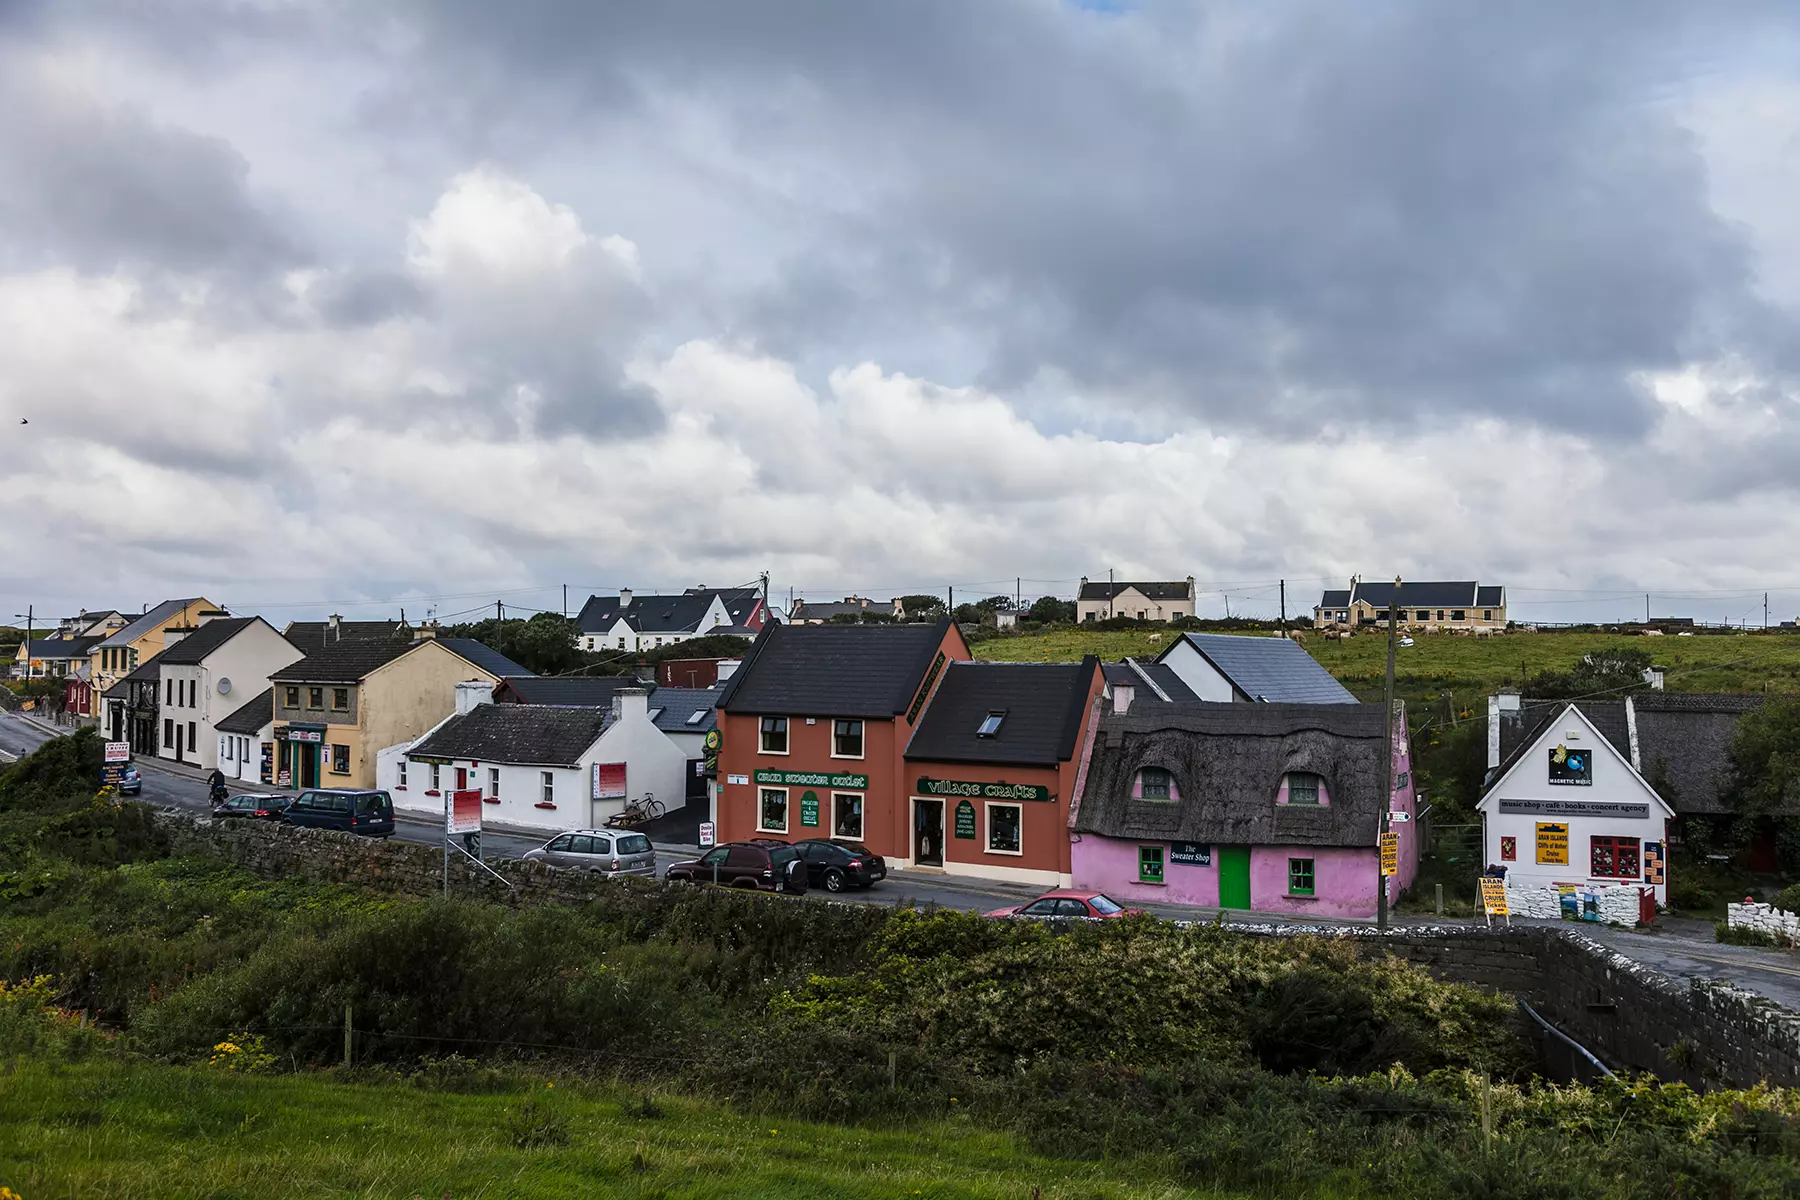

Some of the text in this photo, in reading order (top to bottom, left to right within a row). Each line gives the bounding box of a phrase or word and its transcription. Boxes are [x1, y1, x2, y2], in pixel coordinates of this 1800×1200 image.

[1524, 801, 1541, 809] shop
[1620, 805, 1647, 813] agency
[1171, 852, 1210, 863] Sweater Shop
[1382, 861, 1397, 869] Tickets
